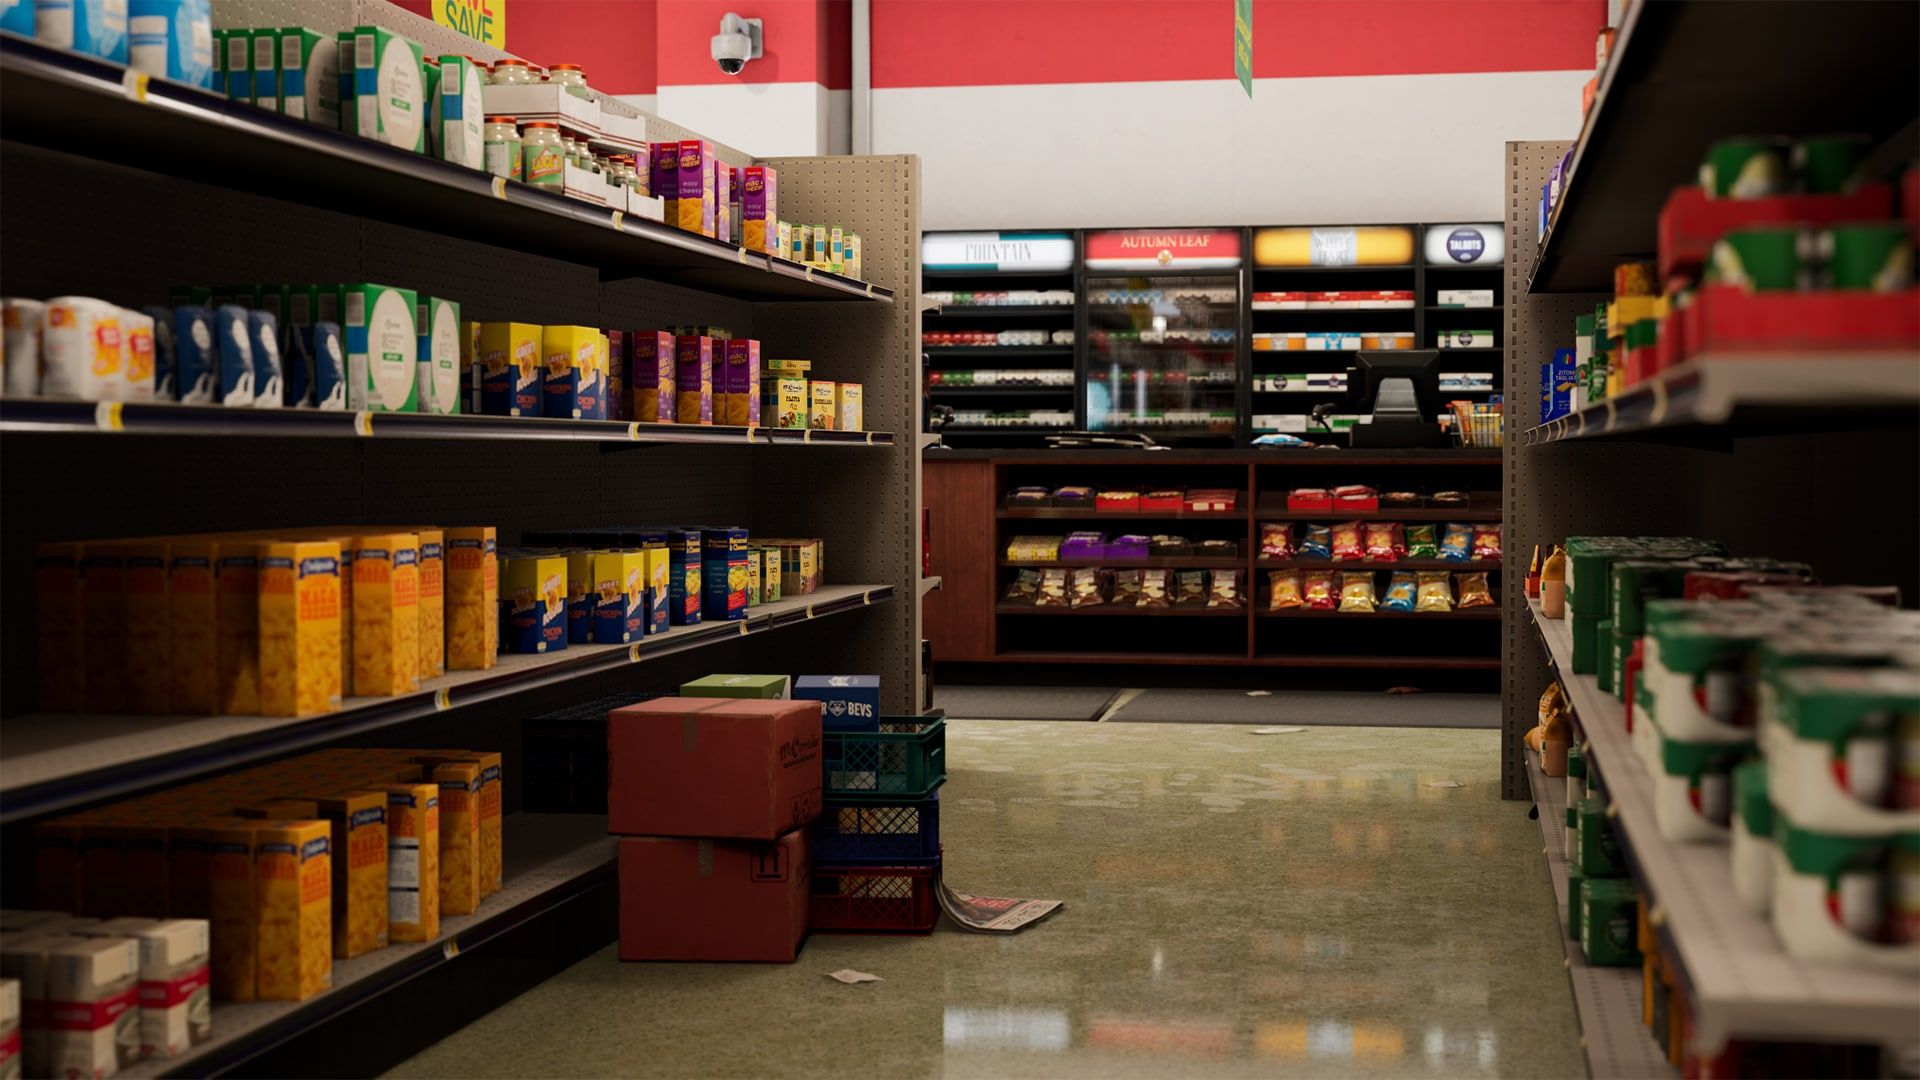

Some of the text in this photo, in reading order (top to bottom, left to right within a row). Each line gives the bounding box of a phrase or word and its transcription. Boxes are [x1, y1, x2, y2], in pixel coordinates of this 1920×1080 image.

[1120, 235, 1210, 248] AUTUMN LEAF
[965, 242, 1031, 261] FOUNTAIN
[848, 702, 873, 718] BEVS
